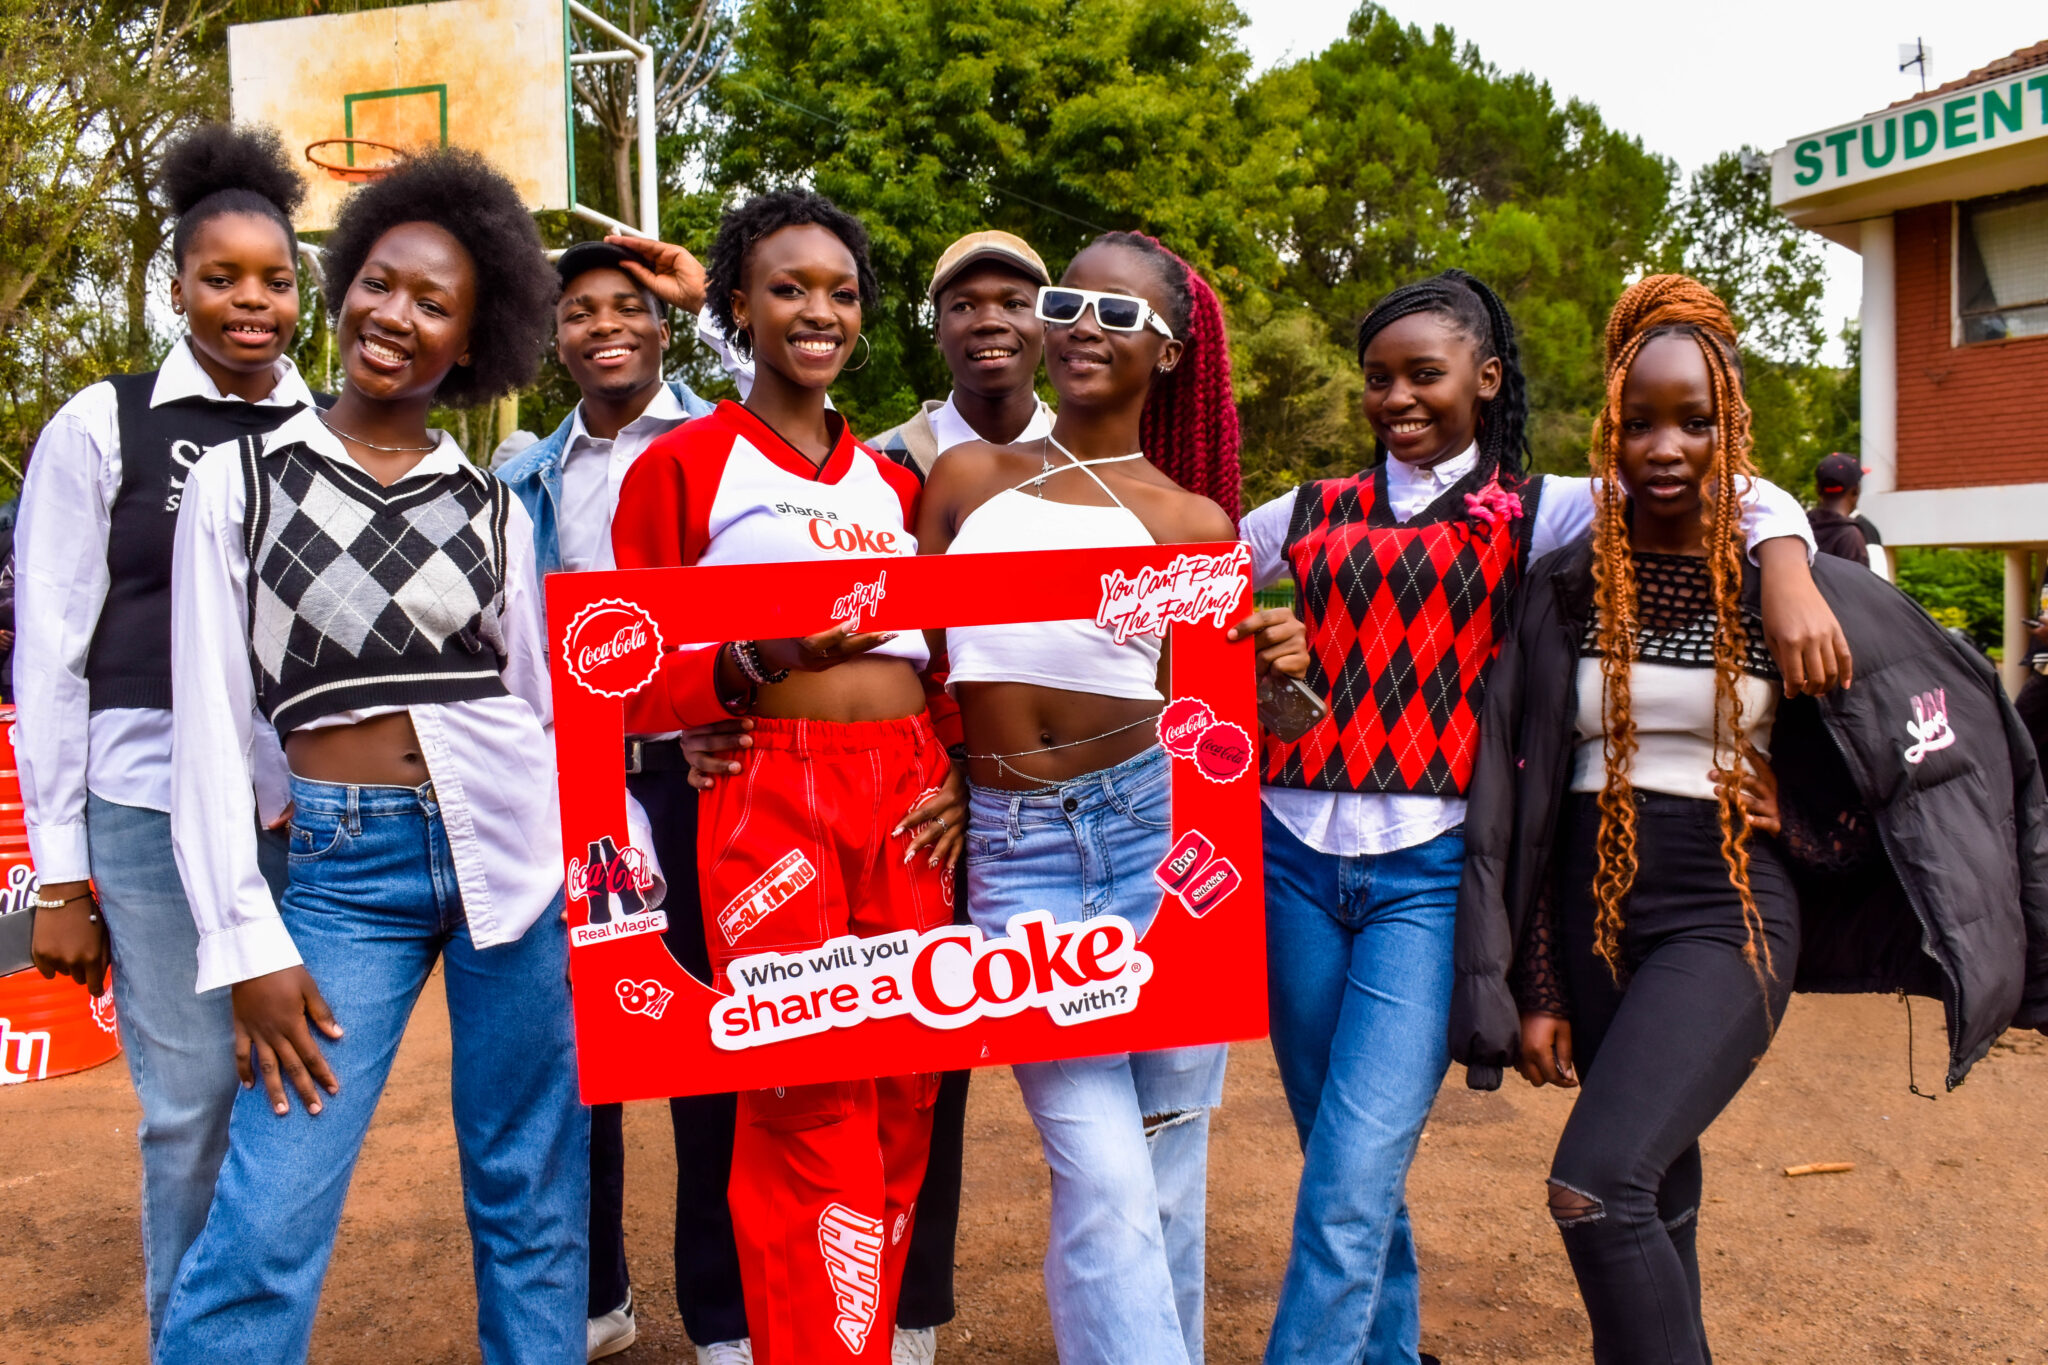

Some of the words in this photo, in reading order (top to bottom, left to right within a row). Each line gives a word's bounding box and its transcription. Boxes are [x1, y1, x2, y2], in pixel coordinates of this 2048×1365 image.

[775, 502, 824, 519] share
[827, 510, 839, 521] a
[808, 517, 898, 554] Coke
[831, 570, 887, 631] enjoy!
[1100, 573, 1134, 623] You
[1137, 558, 1189, 600] Can't
[1186, 548, 1247, 586] Beat
[1114, 602, 1161, 640] The
[1157, 578, 1244, 633] Feeling!
[578, 619, 648, 674] Coca-Cola
[1165, 709, 1208, 744] Coca-Cola
[1200, 738, 1246, 764] Coca-Cola
[568, 846, 652, 901] Coca-Cola
[750, 873, 775, 895] BEAT
[778, 854, 799, 870] THE
[1169, 848, 1197, 876] Bro
[1192, 871, 1227, 900] Sidekick
[577, 925, 612, 942] Real
[614, 916, 660, 935] Magic
[722, 980, 859, 1036] share
[871, 974, 903, 1006] a
[912, 920, 1128, 1017] Coke
[740, 961, 803, 988] Who
[808, 945, 857, 974] will
[860, 939, 909, 967] you
[1060, 985, 1129, 1017] with?
